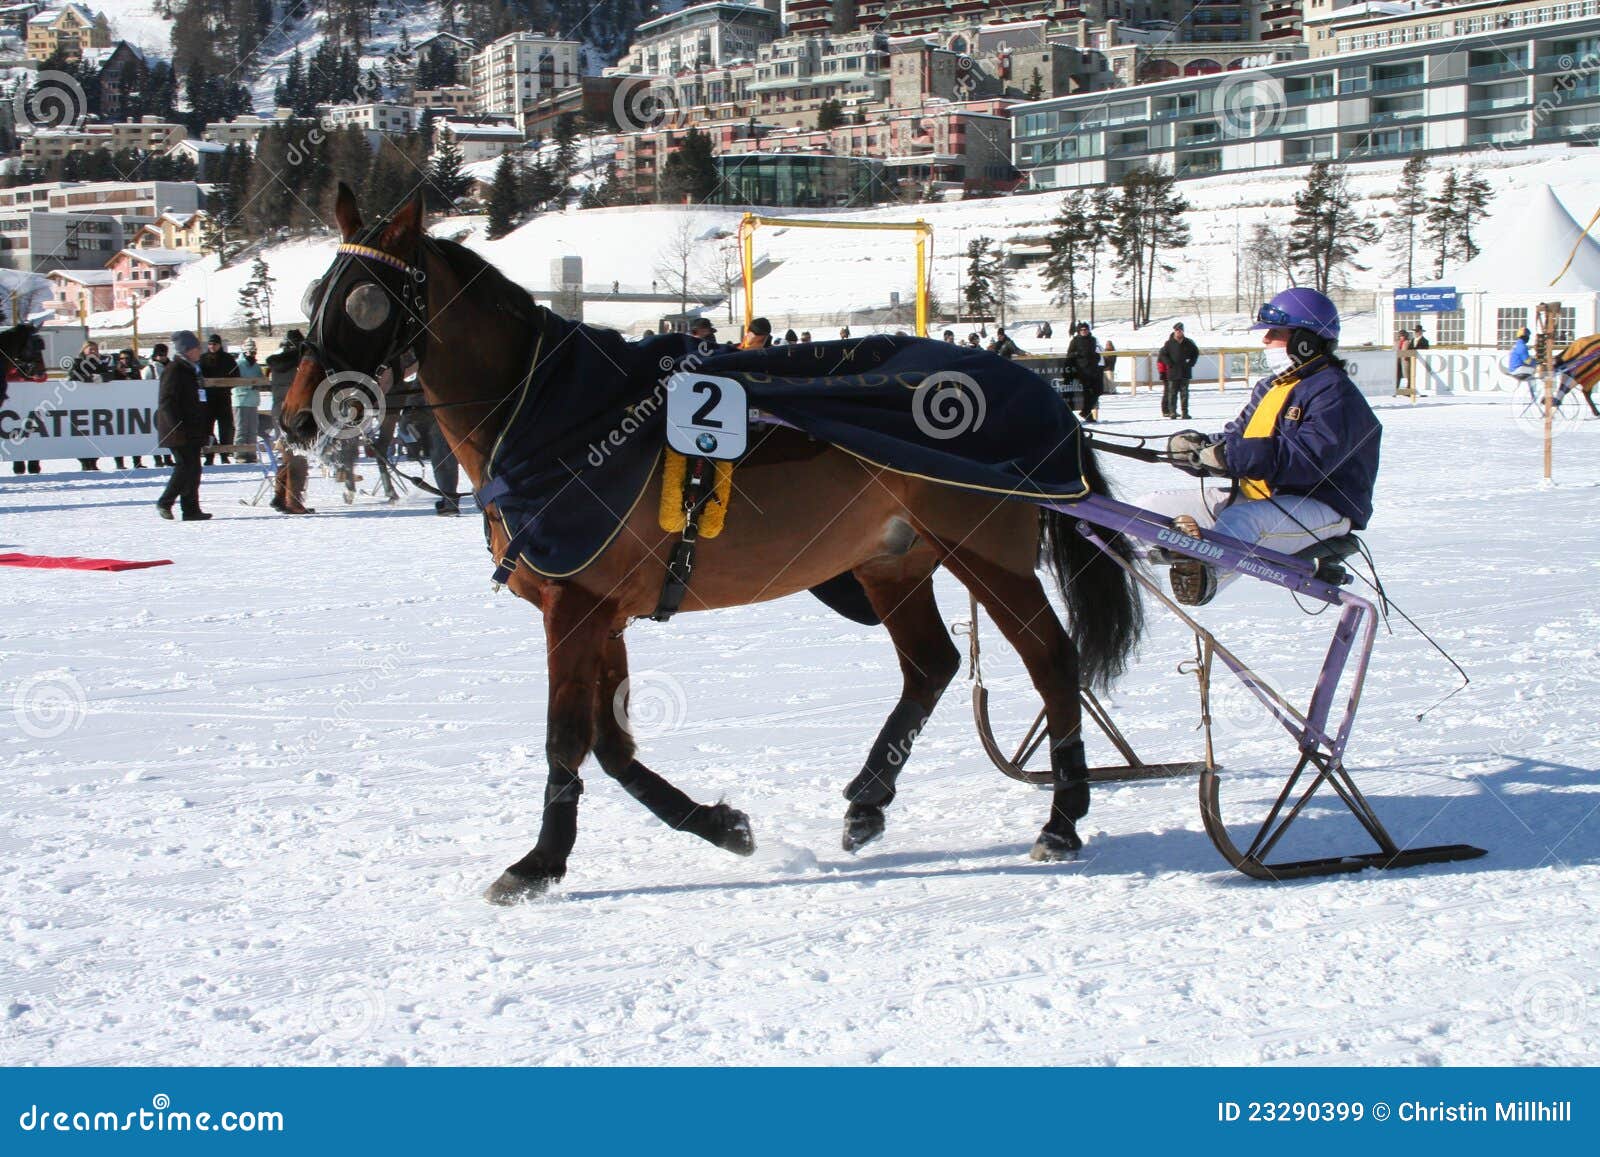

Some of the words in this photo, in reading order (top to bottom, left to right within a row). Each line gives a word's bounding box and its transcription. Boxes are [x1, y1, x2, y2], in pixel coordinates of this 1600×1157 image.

[691, 380, 723, 429] 2
[1156, 528, 1225, 560] CUSTOM
[1236, 559, 1289, 582] MULTIFLEX
